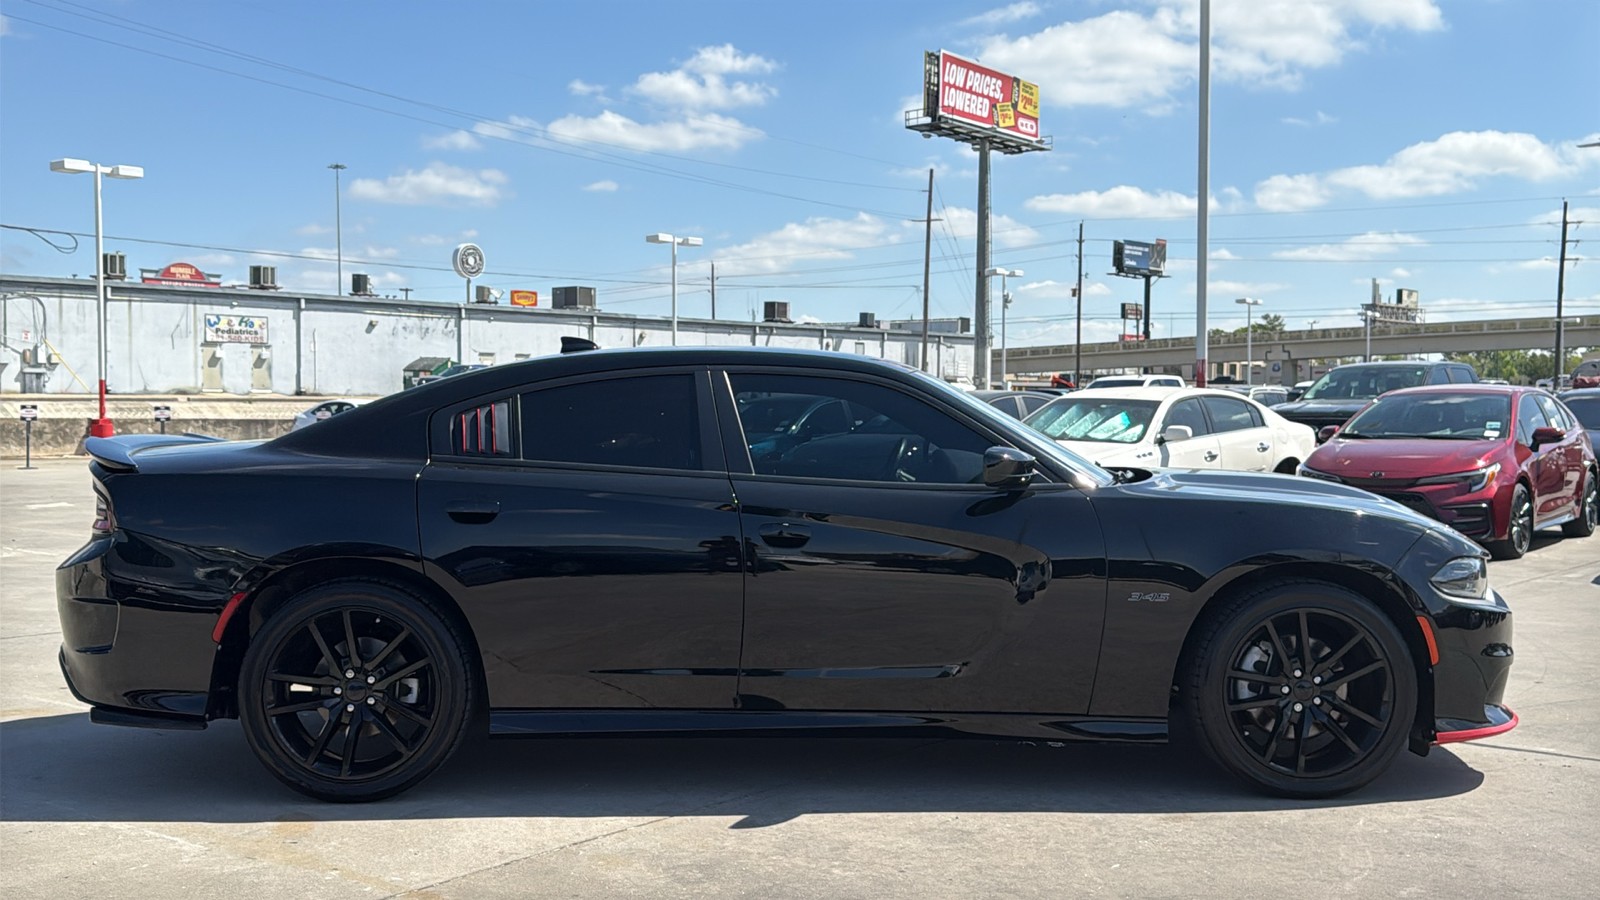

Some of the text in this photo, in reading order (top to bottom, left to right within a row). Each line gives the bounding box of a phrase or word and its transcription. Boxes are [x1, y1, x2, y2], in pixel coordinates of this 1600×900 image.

[944, 61, 967, 88] LOW
[966, 69, 1004, 103] PRICES,
[943, 86, 990, 118] LOWERED
[215, 327, 259, 336] Pediatrics
[1127, 592, 1170, 602] 345
